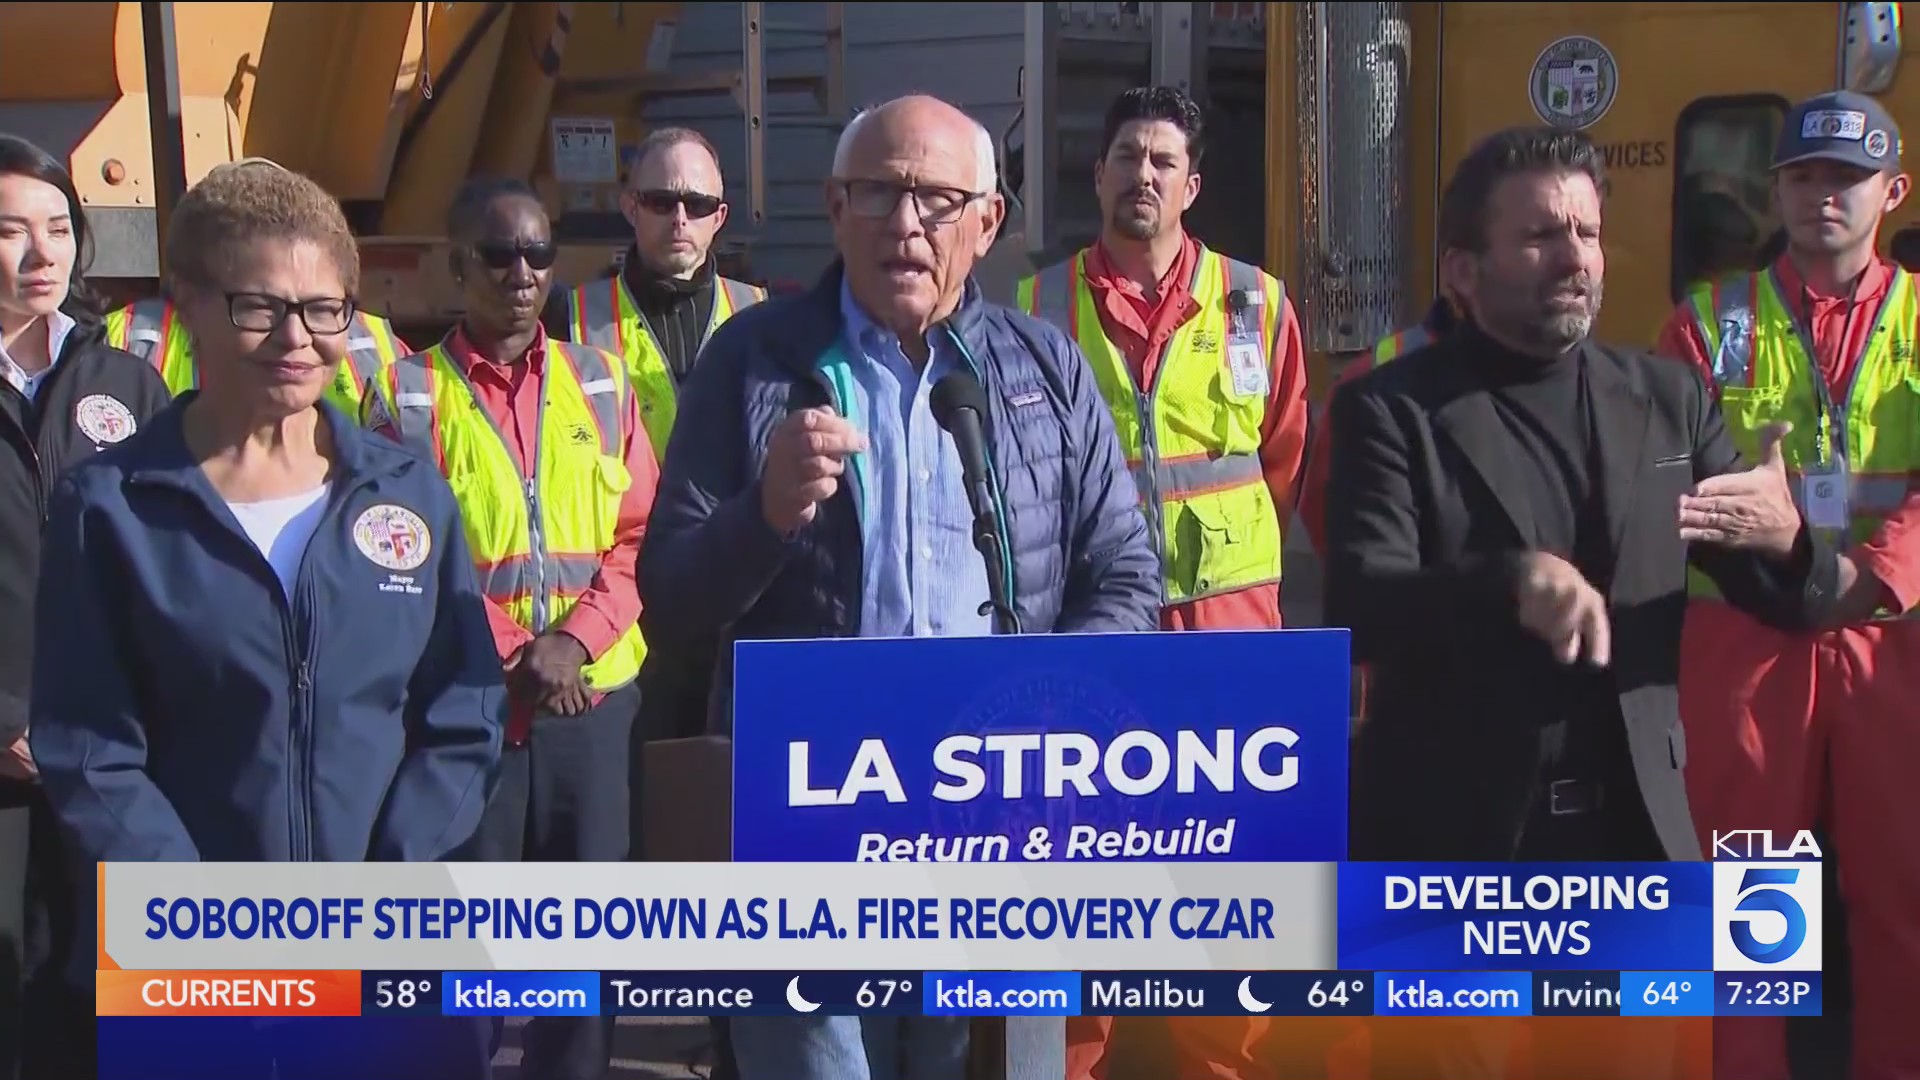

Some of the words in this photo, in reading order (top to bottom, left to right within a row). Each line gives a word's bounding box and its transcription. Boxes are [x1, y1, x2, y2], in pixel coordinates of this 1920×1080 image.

[1594, 141, 1666, 169] VICES
[788, 739, 908, 807] LA
[932, 726, 1300, 802] STRONG
[856, 833, 1010, 862] Return
[1022, 826, 1053, 861] &
[1065, 818, 1236, 859] Rebuild
